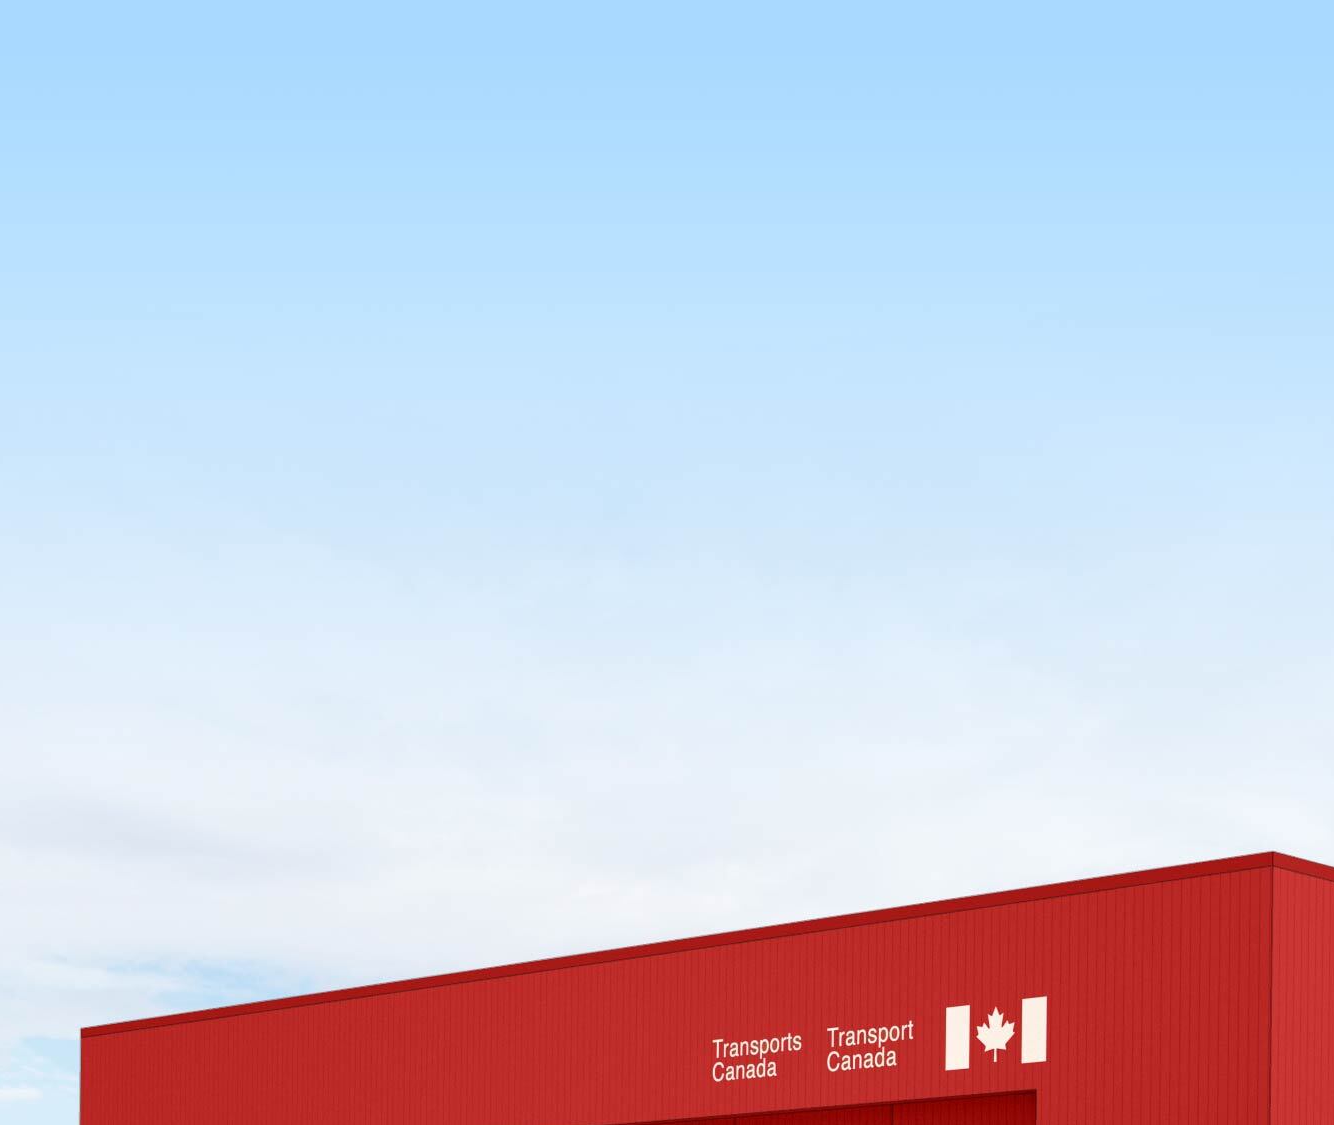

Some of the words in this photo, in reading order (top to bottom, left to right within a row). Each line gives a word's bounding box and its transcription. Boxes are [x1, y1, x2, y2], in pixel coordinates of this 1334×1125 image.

[712, 1033, 802, 1059] Transports
[826, 1020, 914, 1048] Transport
[712, 1058, 777, 1082] Canada
[826, 1047, 897, 1072] Canada
